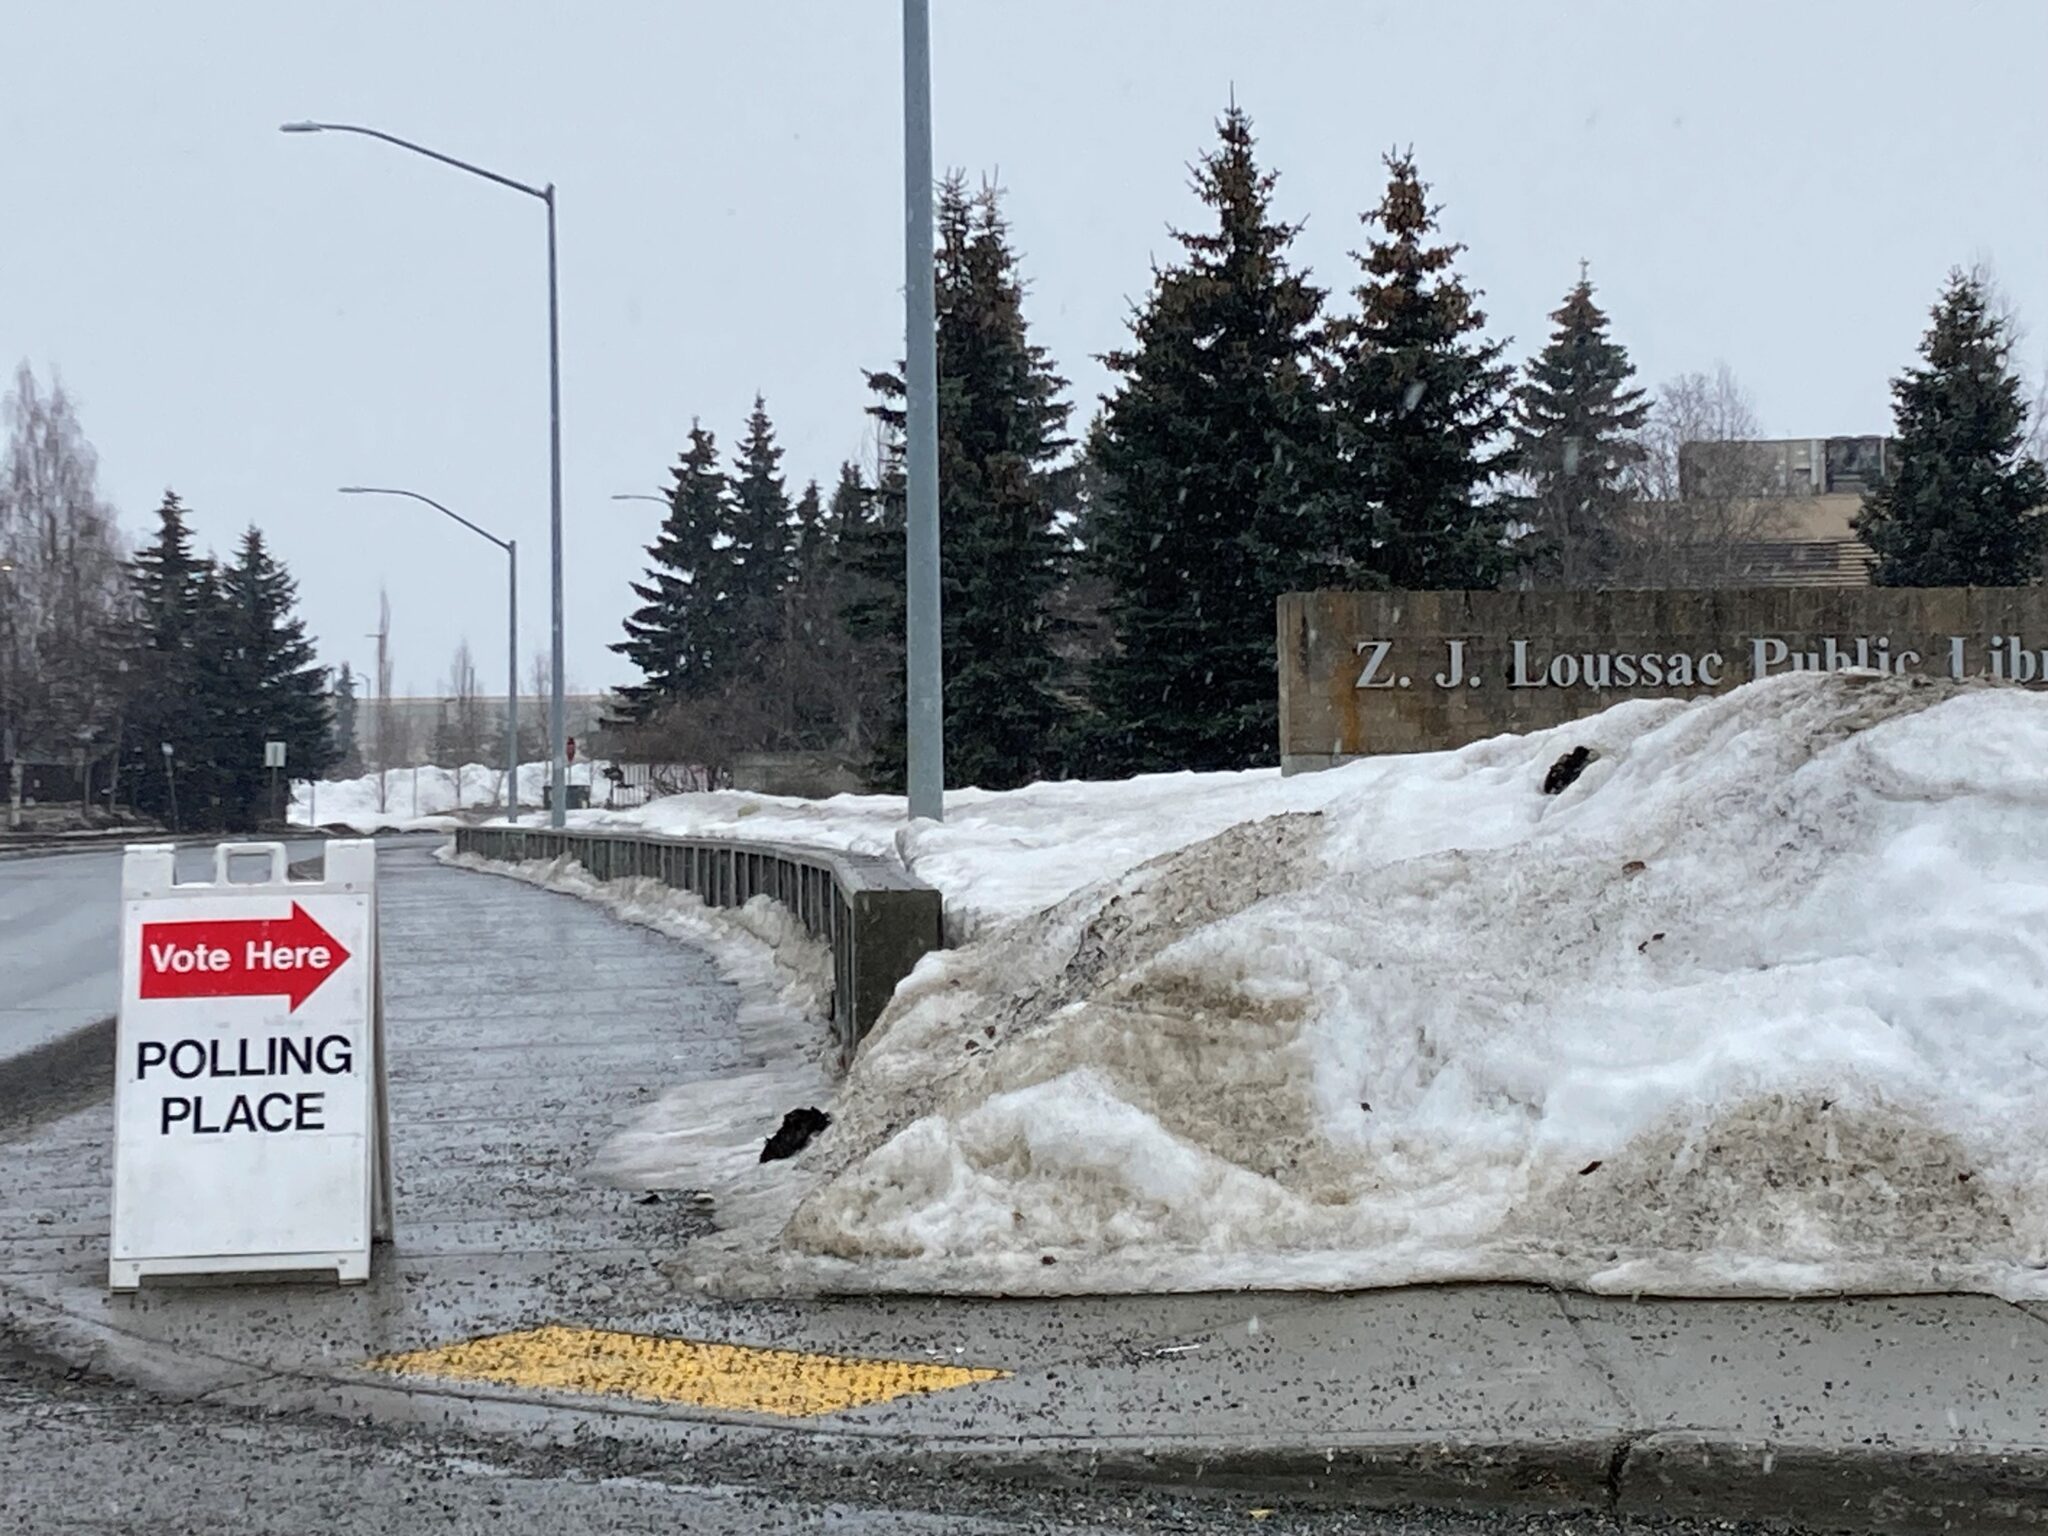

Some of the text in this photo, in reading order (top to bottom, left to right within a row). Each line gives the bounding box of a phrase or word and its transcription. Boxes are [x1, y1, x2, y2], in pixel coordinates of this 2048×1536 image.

[1355, 640, 1411, 688] Z.
[1435, 639, 1481, 688] J.
[1508, 639, 1723, 688] Loussac
[149, 940, 331, 973] Vote Here
[136, 1034, 353, 1080] POLLING
[161, 1091, 326, 1135] PLACE
